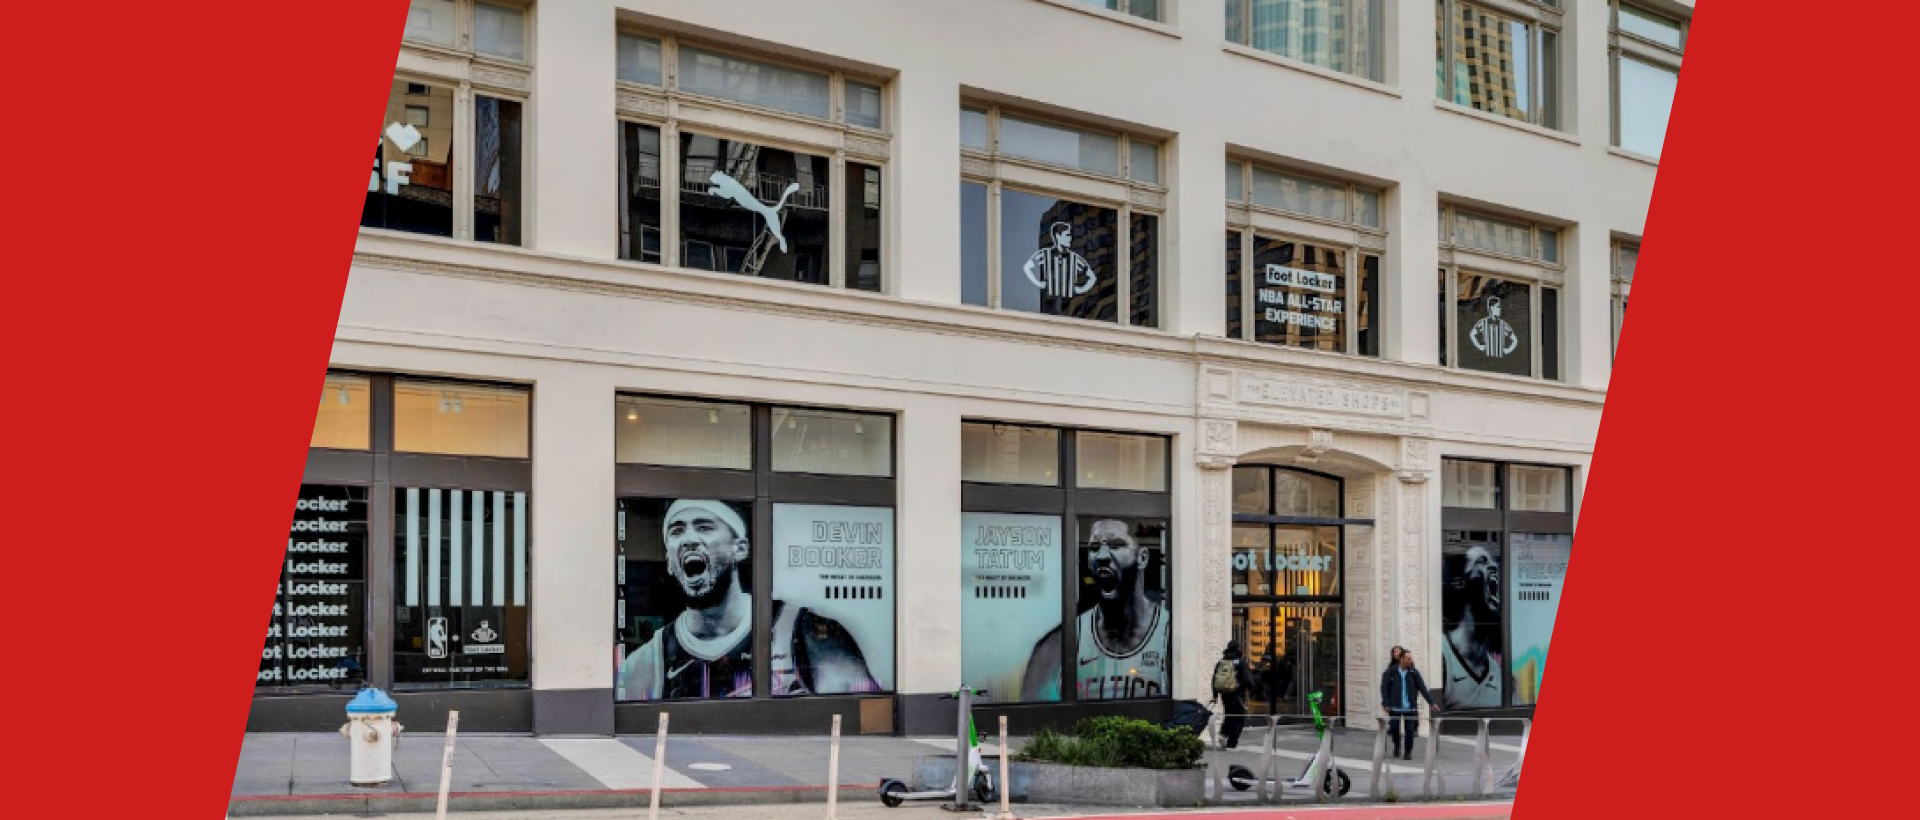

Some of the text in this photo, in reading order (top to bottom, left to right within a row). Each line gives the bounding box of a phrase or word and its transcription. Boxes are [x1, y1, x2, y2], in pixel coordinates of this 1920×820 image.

[1268, 266, 1334, 289] Foot Locker
[1260, 288, 1342, 313] NBA ALL-STAR
[1265, 307, 1336, 331] EXPERIENCE
[1261, 383, 1333, 406] ELEVATED
[1343, 392, 1388, 411] SHOPS
[295, 496, 348, 511] ocker
[813, 520, 883, 544] DEVIN
[975, 525, 1051, 547] JAYSON
[287, 538, 348, 553] Locker
[788, 545, 883, 569] BOOKER
[975, 548, 1044, 571] TATUM
[287, 559, 348, 574] Locker
[287, 580, 348, 595] Locker
[287, 602, 348, 616] Locker
[287, 623, 348, 637] Locker
[287, 644, 348, 659] Locker
[287, 665, 348, 680] Locker
